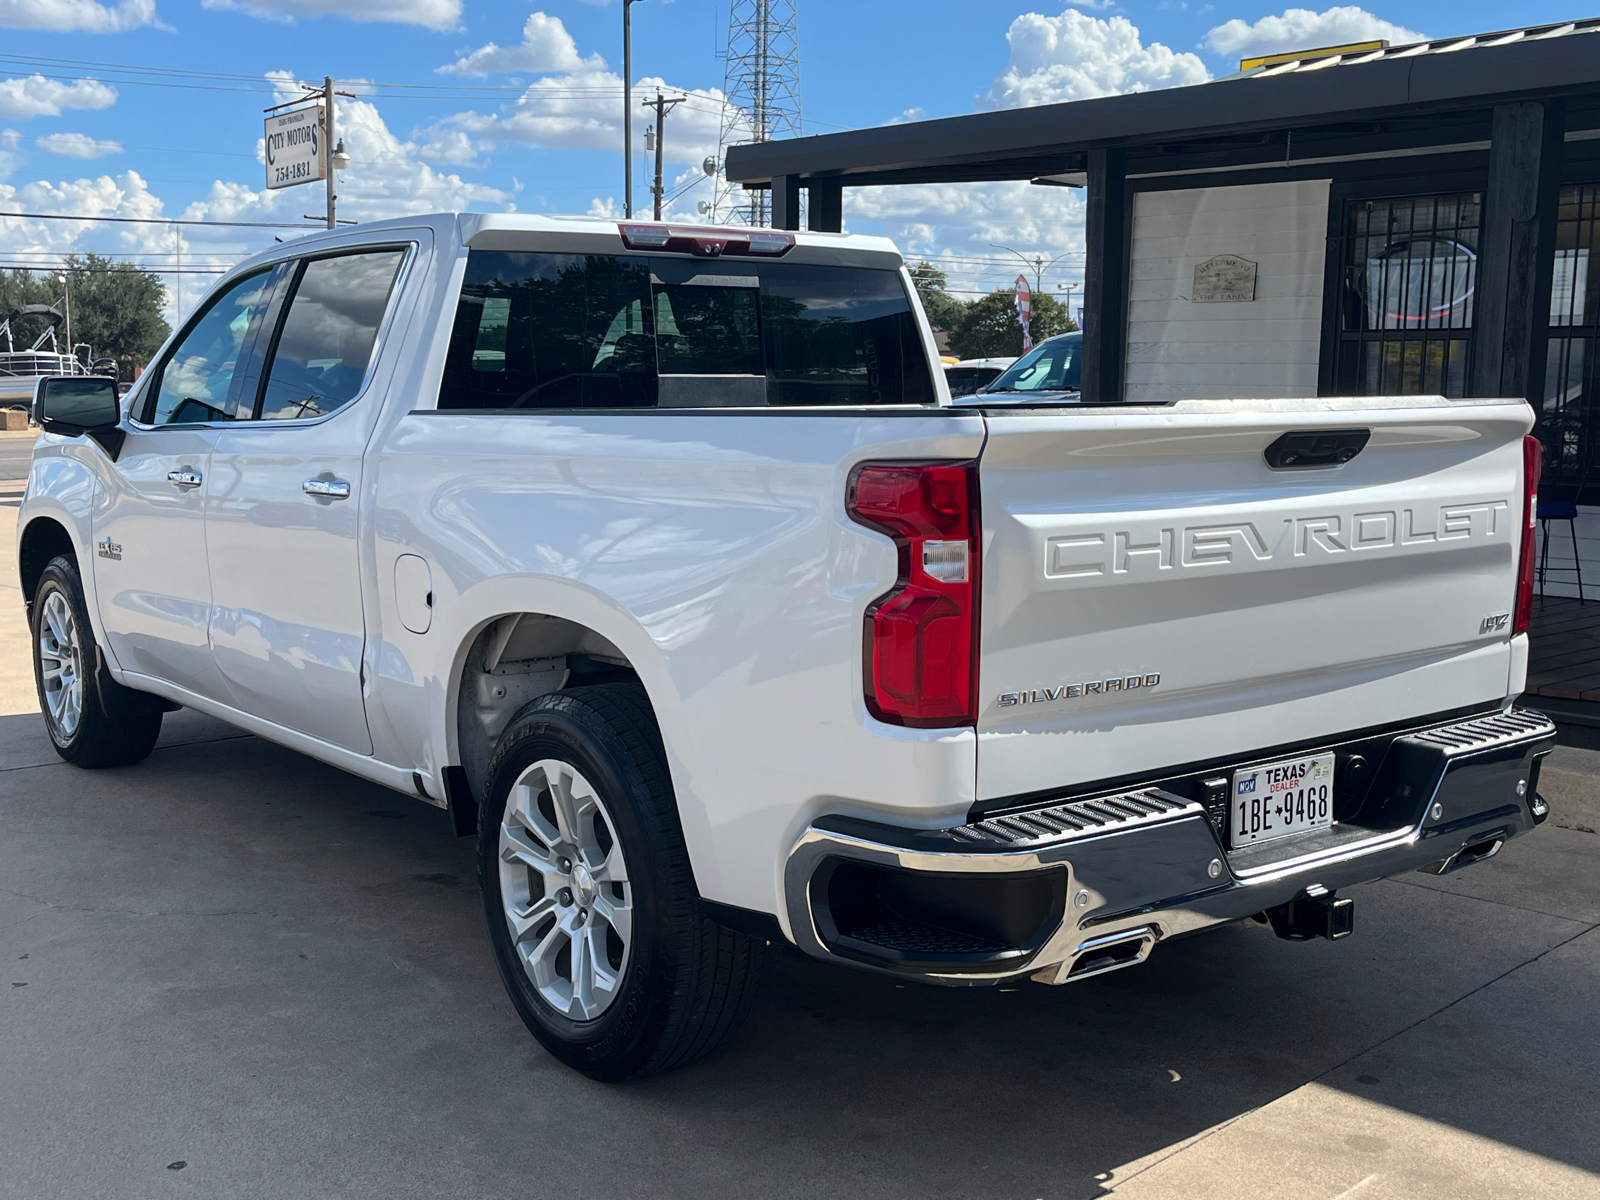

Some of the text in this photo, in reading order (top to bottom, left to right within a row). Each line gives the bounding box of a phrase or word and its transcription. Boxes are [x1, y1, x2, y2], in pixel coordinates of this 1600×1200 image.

[267, 123, 318, 166] CITY MOTORS
[275, 161, 311, 182] 754-1831
[1199, 259, 1250, 274] WELCOME TO
[1044, 499, 1508, 580] CHEVROLET
[1482, 613, 1510, 628] LTZ
[996, 672, 1161, 708] SILVERADO
[1266, 763, 1306, 784] TEXAS
[1239, 781, 1255, 792] NOV
[1270, 779, 1300, 793] DEALER
